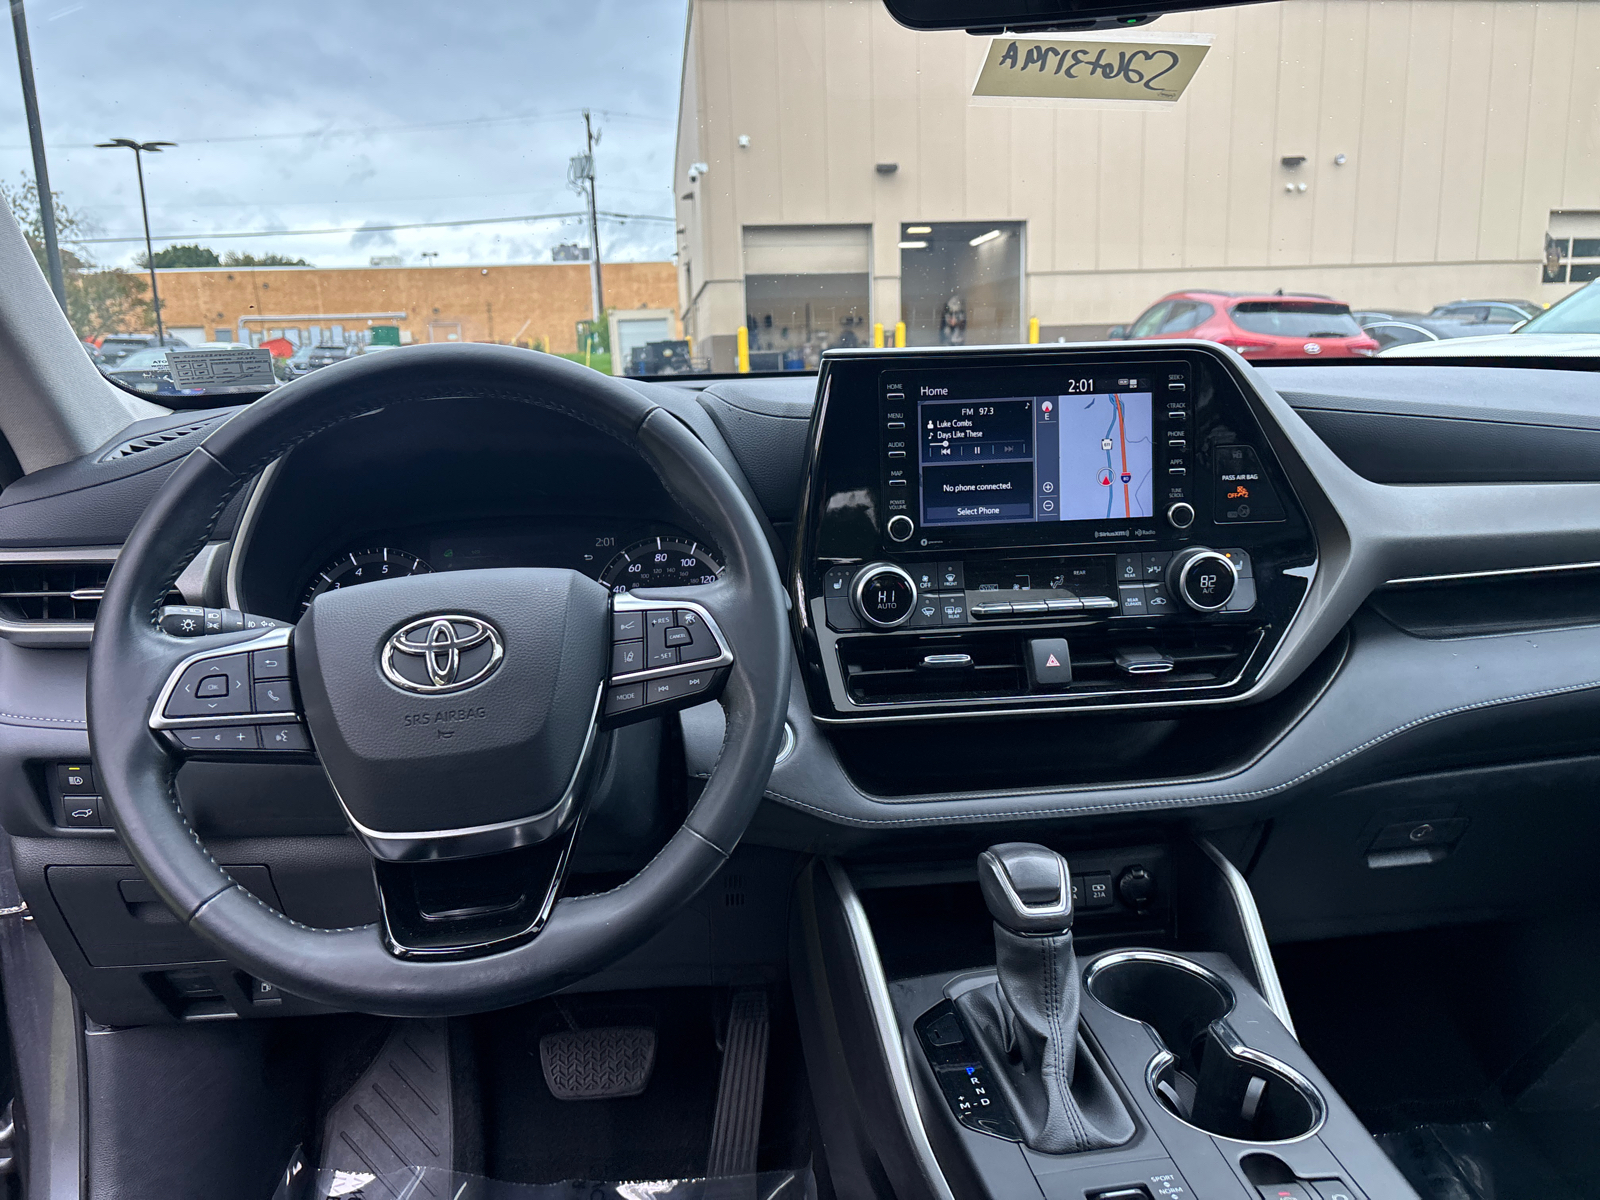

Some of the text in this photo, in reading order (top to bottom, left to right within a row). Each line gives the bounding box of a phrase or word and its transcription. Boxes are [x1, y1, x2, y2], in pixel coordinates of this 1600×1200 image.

[1068, 379, 1094, 392] 2:01
[920, 386, 948, 396] Home
[979, 407, 994, 415] 97.3
[937, 431, 952, 439] Days
[955, 484, 975, 493] phone
[977, 482, 1012, 490] connected.
[595, 537, 615, 547] 2:01
[680, 558, 696, 567] 100
[355, 568, 362, 576] 4
[382, 565, 389, 574] 5
[628, 564, 641, 572] 60
[700, 575, 715, 584] 120
[1200, 575, 1216, 588] 82
[613, 585, 626, 593] 40
[405, 707, 486, 727] SRS AIRBAG
[965, 1067, 975, 1076] P
[1150, 1174, 1174, 1182] SPORT
[1158, 1186, 1184, 1195] NORM
